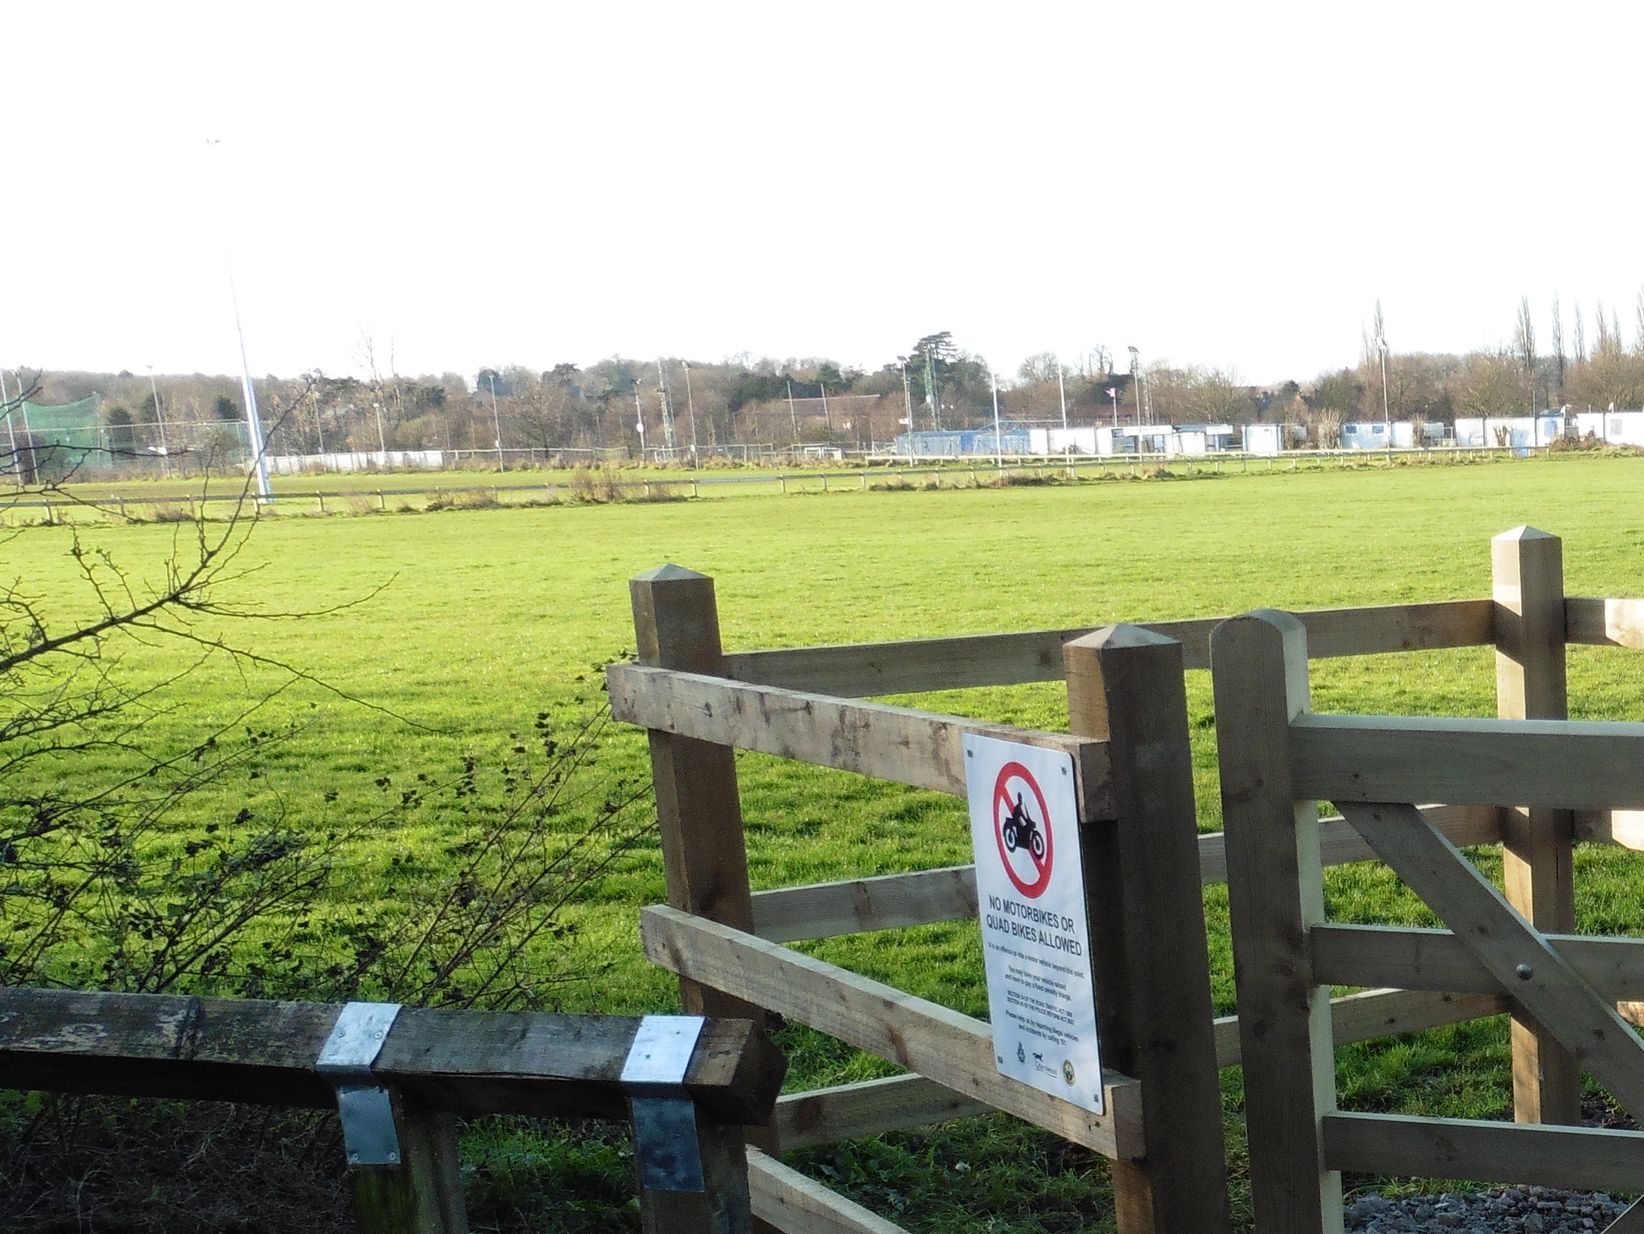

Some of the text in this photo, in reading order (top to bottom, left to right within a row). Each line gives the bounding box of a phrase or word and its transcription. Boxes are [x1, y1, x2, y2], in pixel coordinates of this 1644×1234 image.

[989, 895, 1074, 934] NO MOTORBIKES OR
[987, 914, 1082, 956] QUAD BIKES ALLOWED
